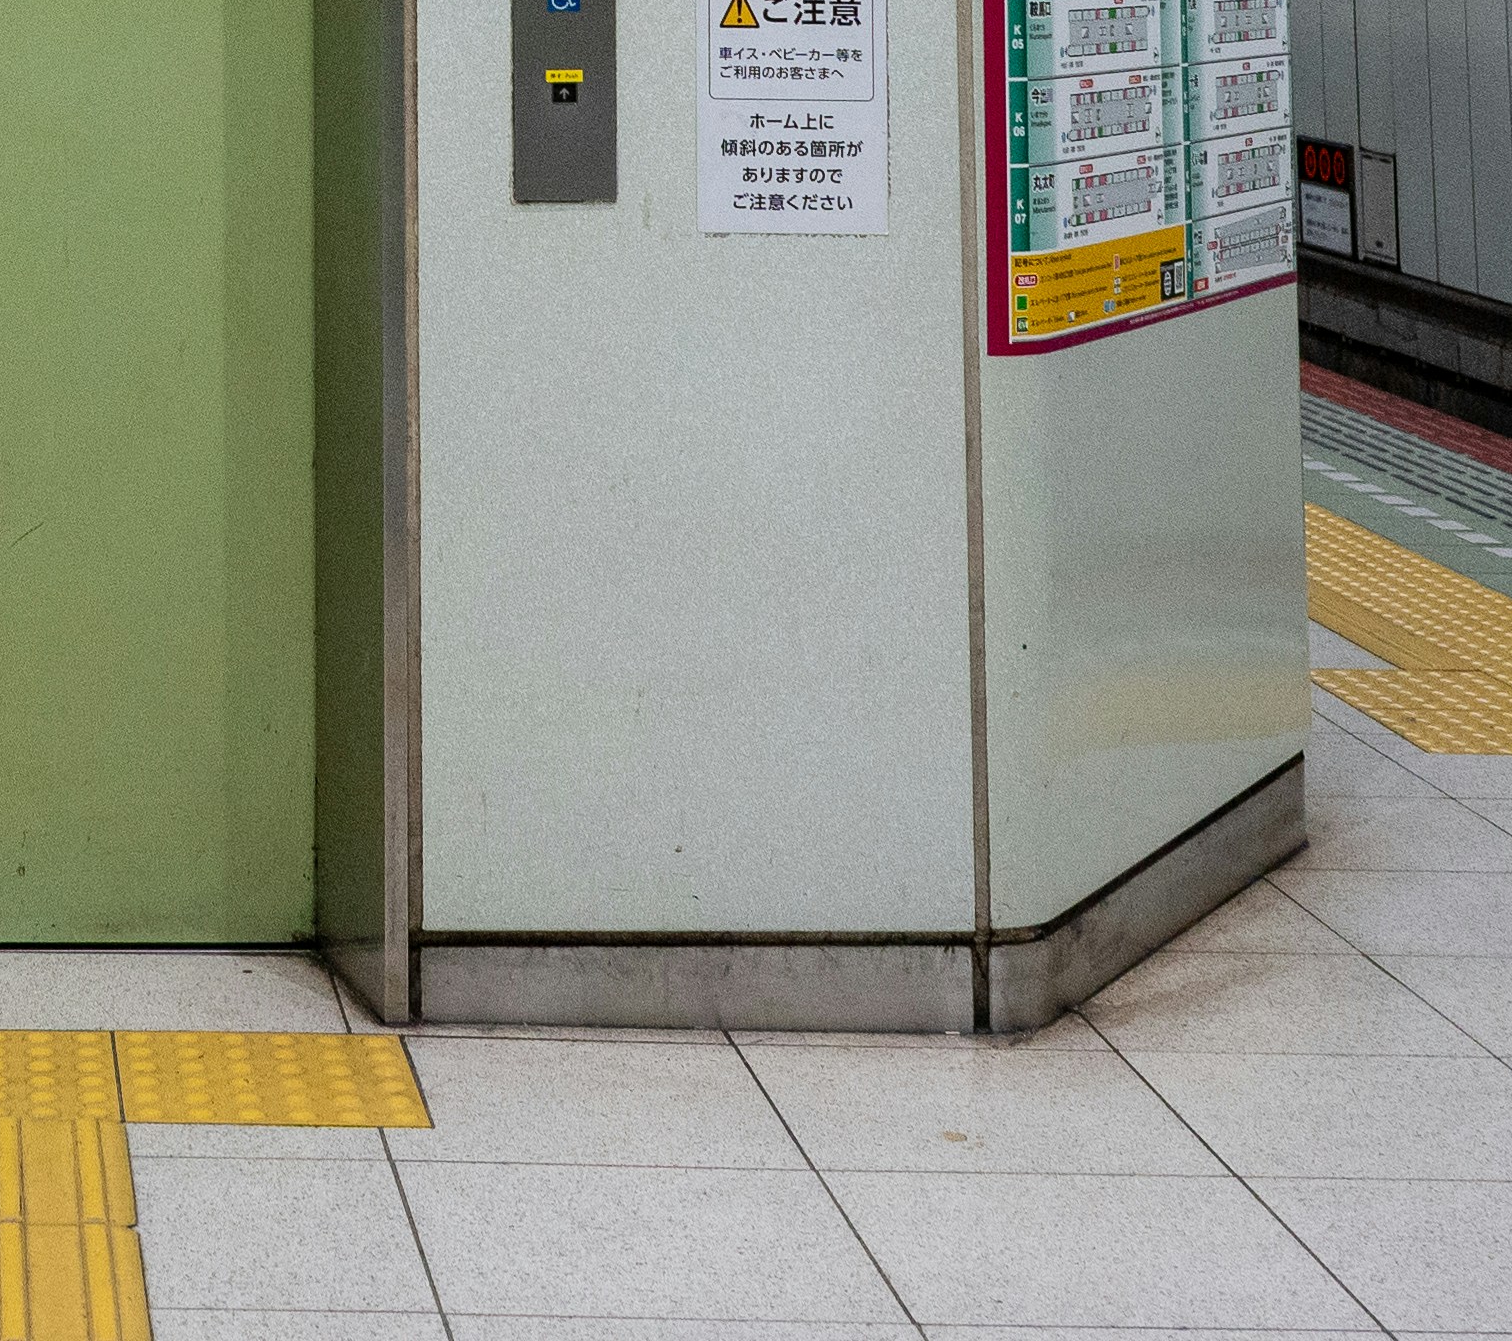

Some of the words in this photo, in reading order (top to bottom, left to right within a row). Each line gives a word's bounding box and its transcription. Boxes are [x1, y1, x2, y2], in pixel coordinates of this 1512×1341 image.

[1014, 24, 1022, 35] K
[1011, 38, 1024, 50] 05
[719, 46, 863, 62] 車イス・ベビーカー等を
[719, 65, 844, 80] ご利用のお客さまへ
[749, 114, 834, 130] ホーム上に
[1015, 112, 1023, 123] K
[1013, 126, 1025, 137] 06
[720, 139, 863, 158] 傾斜のある箇所が
[742, 166, 843, 184] ありますので
[732, 193, 853, 212] ご注意ください
[1016, 199, 1025, 210] K
[1014, 213, 1026, 225] 07
